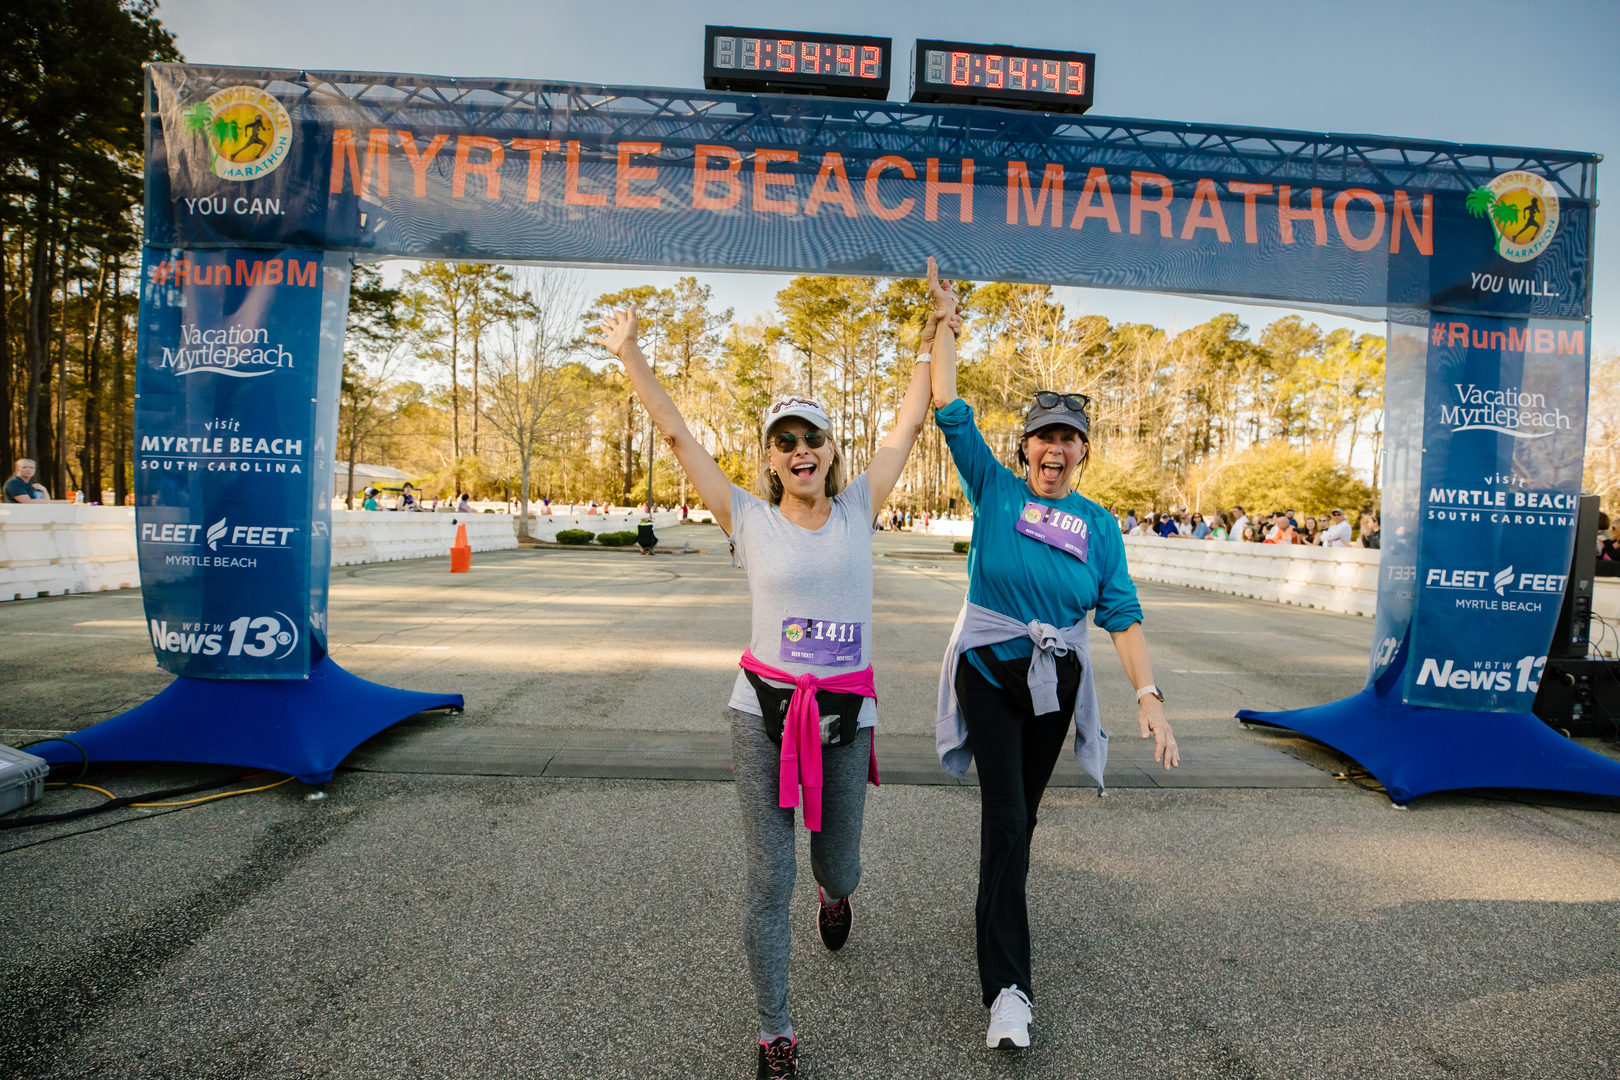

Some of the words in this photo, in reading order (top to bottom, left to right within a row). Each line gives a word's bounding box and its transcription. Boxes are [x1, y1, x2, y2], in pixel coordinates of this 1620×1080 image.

[755, 39, 880, 79] 1:54:42
[951, 52, 1084, 95] 0:54:43
[211, 88, 256, 109] MYRTLE
[257, 94, 289, 130] BEACH
[223, 136, 287, 177] MARATHON
[329, 128, 661, 208] MYRTLE
[692, 144, 975, 222] BEACH
[1006, 160, 1434, 256] MARATHON
[1493, 173, 1531, 191] MYRTLE
[184, 197, 227, 215] YOU
[233, 198, 286, 215] CAN.
[1506, 219, 1555, 258] MARATHON
[151, 259, 318, 288] #RunMBM
[1471, 272, 1503, 293] YOU
[1508, 278, 1560, 297] WILL.
[181, 323, 270, 345] Vacation
[1431, 321, 1584, 355] #RunMBM
[159, 344, 295, 371] MyrtleBeach
[1455, 383, 1546, 408] Vacation
[204, 417, 241, 432] visit
[1440, 404, 1572, 429] MyrtleBeach
[140, 436, 223, 453] MYRTLE
[230, 437, 302, 455] BEACH
[141, 460, 198, 471] SOUTH
[208, 461, 302, 474] CAROLINA
[1484, 472, 1526, 488] visit
[1428, 488, 1506, 506] MYRTLE
[1514, 492, 1577, 510] BEACH
[1428, 510, 1480, 522] SOUTH
[1491, 513, 1575, 527] CAROLINA
[142, 523, 202, 543] FLEET
[231, 526, 294, 546] FEET
[165, 555, 211, 566] MYRTLE
[213, 556, 257, 568] BEACH
[1426, 568, 1490, 588] FLEET
[1518, 573, 1568, 592] FEET
[1456, 599, 1498, 610] MYRTLE
[1501, 601, 1542, 612] BEACH
[151, 619, 223, 656] News
[228, 616, 281, 657] 13
[814, 621, 854, 643] 1411
[1416, 658, 1512, 692] News
[1516, 655, 1548, 693] 13
